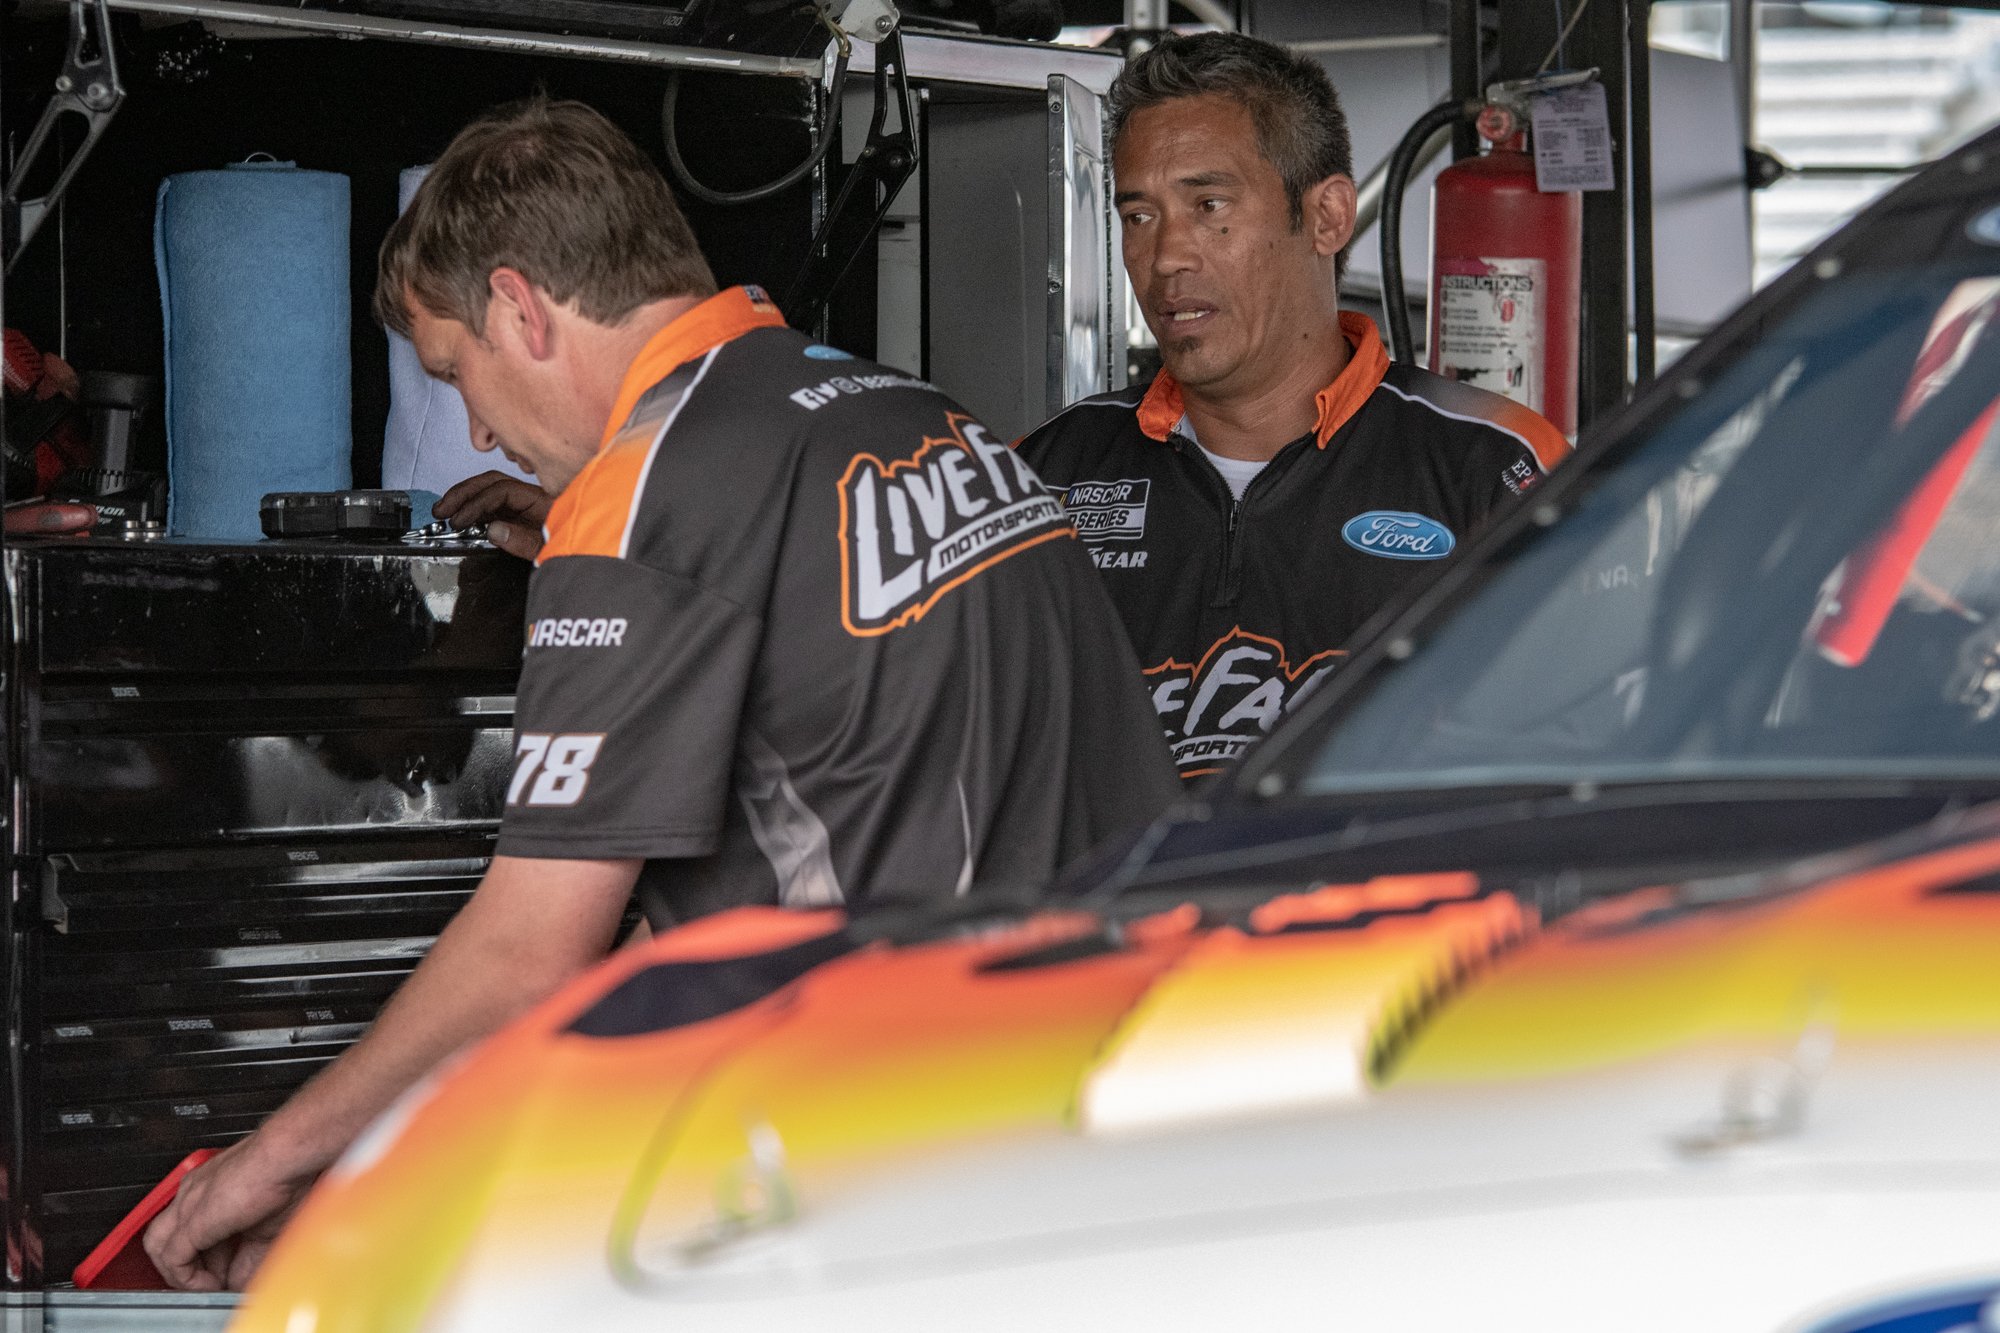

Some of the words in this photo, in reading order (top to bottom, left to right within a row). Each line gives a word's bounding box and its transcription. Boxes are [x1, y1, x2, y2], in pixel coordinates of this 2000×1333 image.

[1070, 484, 1132, 505] NASCAR
[1361, 517, 1439, 553] Ford
[506, 734, 603, 806] 78
